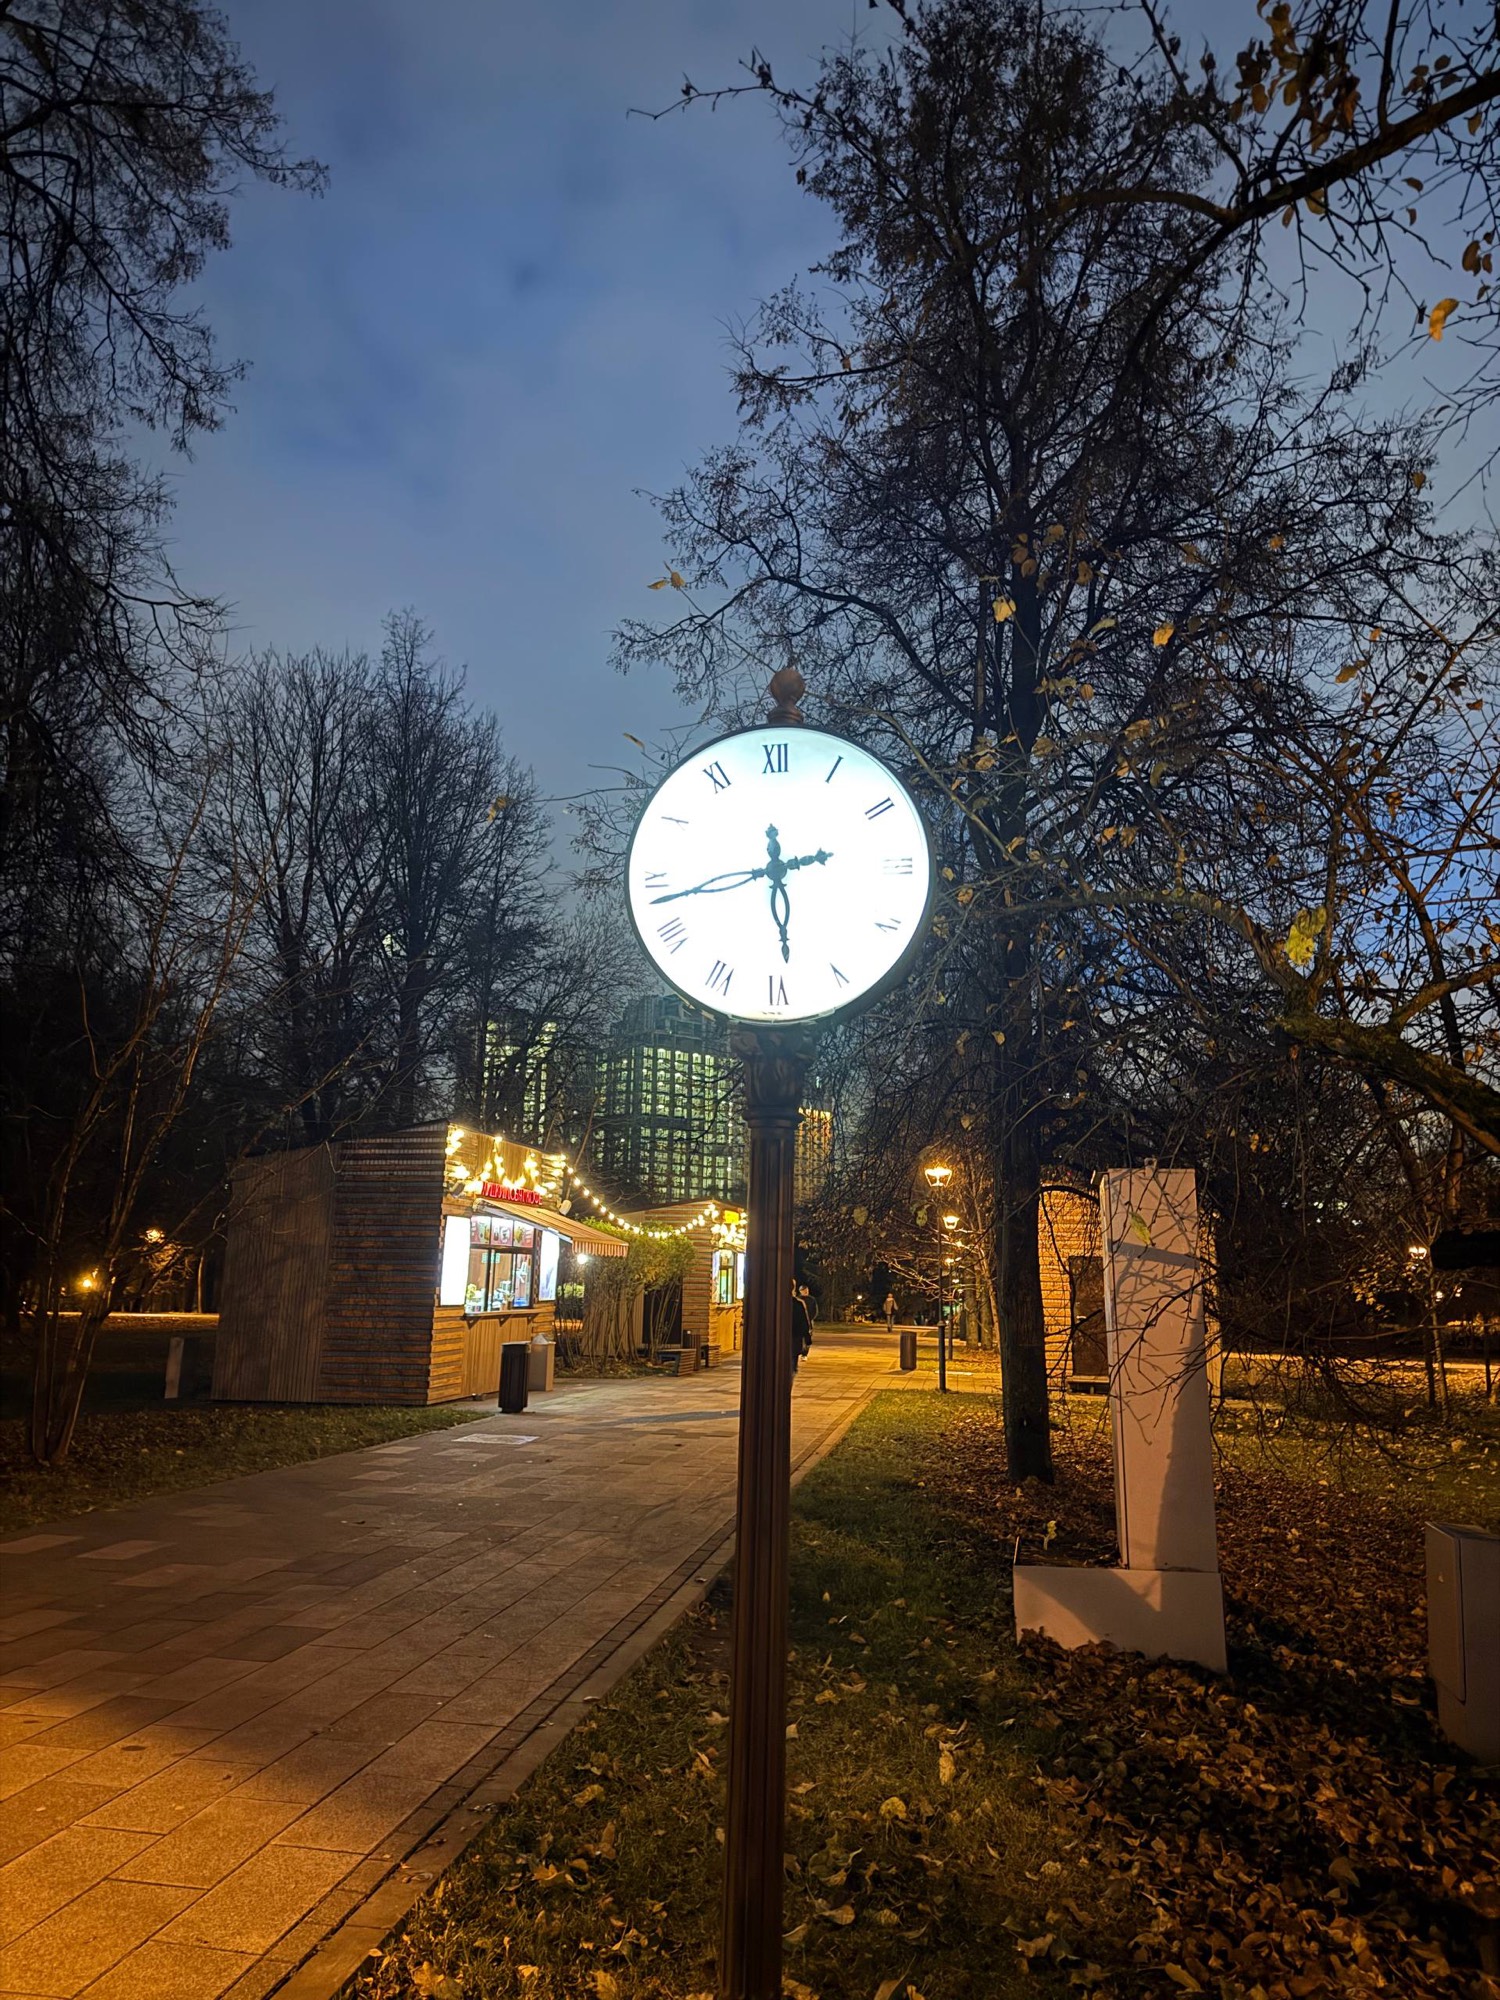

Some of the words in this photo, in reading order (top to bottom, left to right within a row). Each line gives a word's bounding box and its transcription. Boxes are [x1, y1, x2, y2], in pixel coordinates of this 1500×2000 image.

[762, 743, 789, 774] XII
[825, 755, 844, 783] I
[702, 760, 732, 794] XI
[864, 797, 895, 820] II
[657, 917, 690, 954] VIII
[705, 959, 735, 997] VII
[769, 975, 789, 1006] VI
